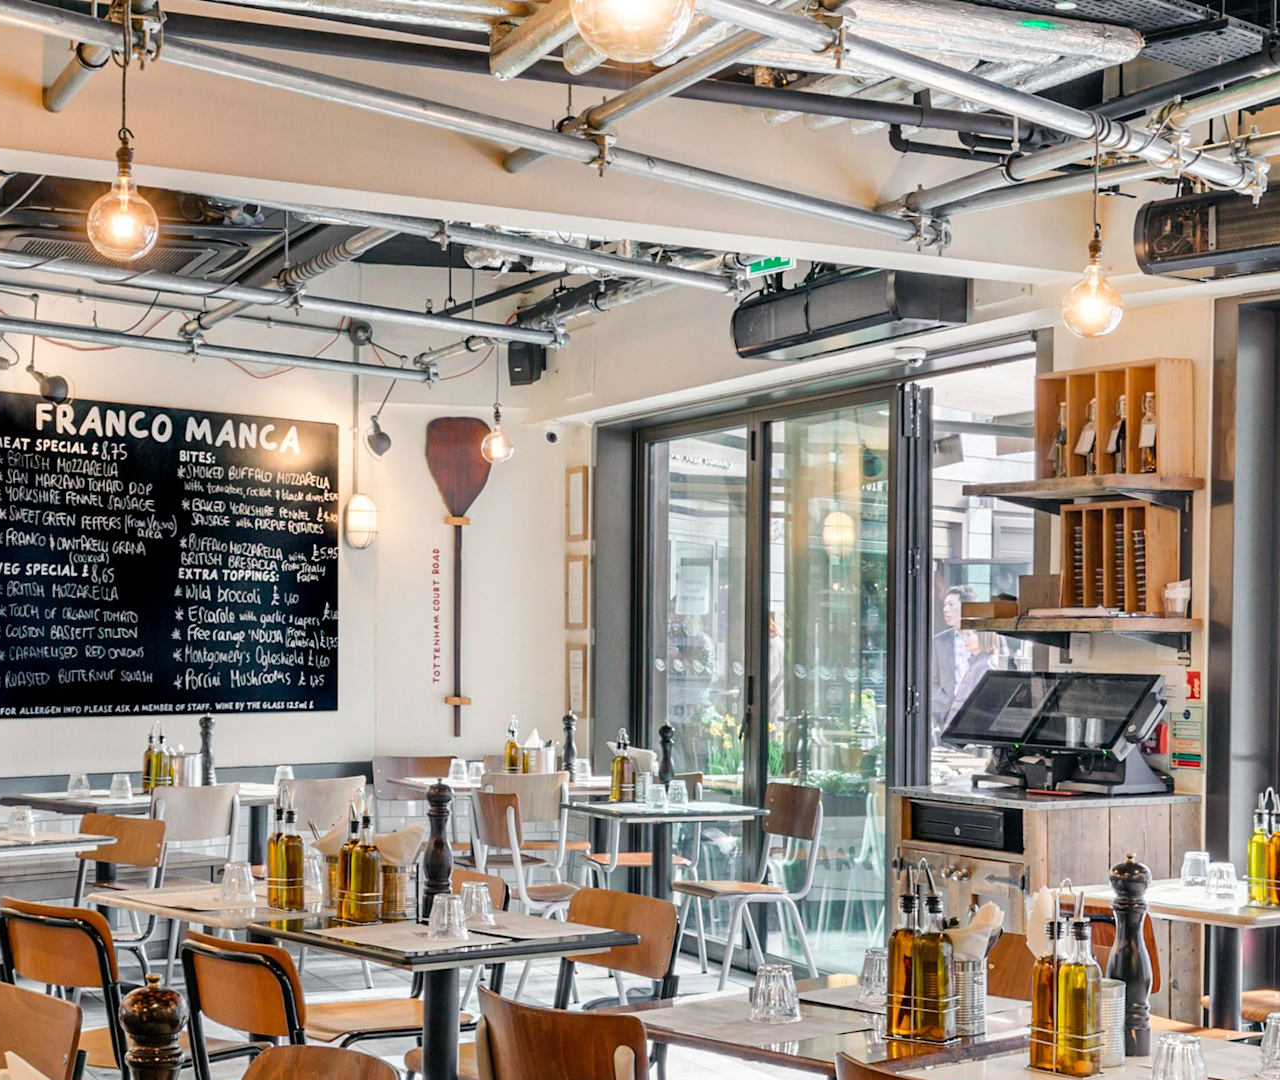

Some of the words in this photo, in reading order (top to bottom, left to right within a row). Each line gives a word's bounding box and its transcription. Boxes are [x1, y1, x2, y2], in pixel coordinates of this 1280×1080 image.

[35, 403, 173, 443] FRANCO
[184, 416, 300, 455] MANCA
[35, 439, 88, 455] SPECIAL
[179, 450, 216, 463] BITES:
[7, 450, 50, 470] BRITISH
[57, 457, 119, 478] MOZZARELLA
[5, 470, 28, 485] SAN
[35, 473, 85, 489] MARZANO
[88, 478, 123, 493] TOMATO
[128, 482, 153, 495] DOP
[184, 481, 204, 493] with
[186, 464, 224, 479] SMOKED
[228, 466, 272, 483] BUFFALO
[277, 472, 330, 490] MOZZARELLA
[5, 486, 61, 505] YORKSHIRE
[66, 491, 104, 508] FENNEL
[107, 495, 156, 512] SAUSAGE
[191, 498, 226, 513] BAKED
[229, 502, 274, 517] YORKSHIRE
[9, 505, 41, 524] SWEET
[42, 511, 76, 527] GREEN
[81, 515, 121, 530] PEPPERS
[191, 513, 231, 527] SAUSAGE
[255, 519, 286, 530] PURPLE
[5, 528, 46, 547] FRANCO
[112, 541, 146, 556] GRANA
[137, 528, 163, 539] area
[188, 533, 228, 552] BUFFALO
[229, 541, 283, 560] MOZZARELLA
[180, 552, 222, 566] BRITISH
[432, 548, 440, 575] ROAD
[25, 563, 78, 577] SPECIAL
[178, 568, 218, 580] EXTRA
[222, 570, 279, 582] TOPPINGS:
[6, 580, 45, 597] BRITISH
[52, 583, 119, 601] MOZZARELLA
[185, 584, 211, 600] Wild
[217, 585, 262, 604] broccoli
[432, 579, 440, 611] COURT
[9, 603, 40, 619] TOUCH
[62, 607, 100, 621] ORGANIC
[102, 611, 139, 623] TOMATO
[239, 611, 257, 622] with
[259, 609, 286, 628] garlic
[6, 624, 45, 639] COLSTON
[50, 625, 96, 640] BASSETT
[97, 627, 138, 639] STILTON
[187, 624, 210, 641] Free
[212, 630, 246, 648] range
[9, 646, 78, 661] CARAMELISED
[85, 645, 106, 658] RED
[108, 647, 144, 659] ONIONS
[432, 615, 441, 683] TOTTENHAM
[5, 670, 50, 688] ROASTED
[58, 668, 116, 684] BUTTERNUT
[120, 670, 153, 683] SQUASH
[0, 707, 16, 715] FOR
[19, 706, 61, 715] ALLERGEN
[63, 705, 82, 714] INFO
[84, 705, 112, 713] PLEASE
[115, 704, 130, 712] ASK
[133, 704, 139, 712] A
[141, 703, 173, 712] MEMBER
[175, 703, 185, 711] OF
[187, 703, 212, 711] STAFF.
[215, 702, 233, 710] WINE
[235, 702, 245, 710] BY
[247, 701, 261, 709] THE
[263, 701, 285, 709] GLASS
